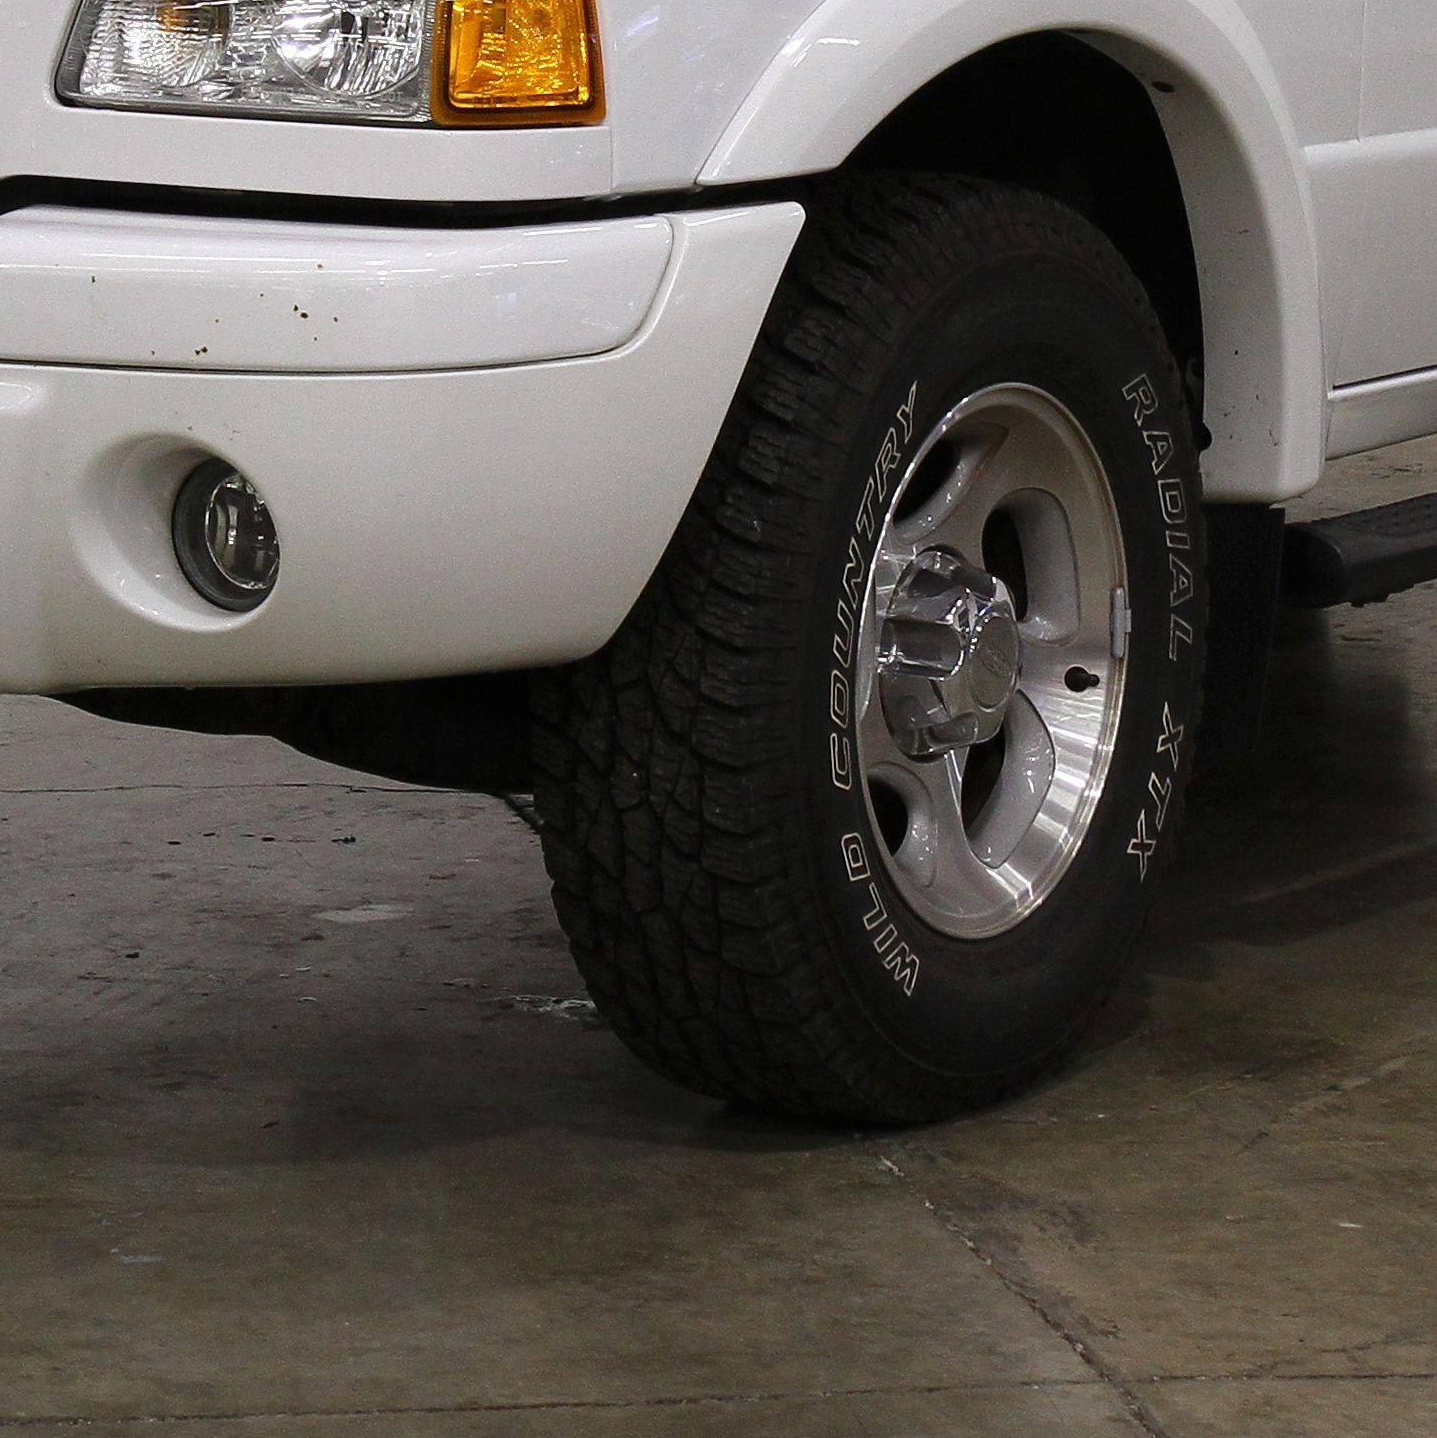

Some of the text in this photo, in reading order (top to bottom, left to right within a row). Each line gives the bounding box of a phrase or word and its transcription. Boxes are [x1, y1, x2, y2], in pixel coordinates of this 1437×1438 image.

[830, 380, 920, 997] WILD COUNTRY
[1121, 373, 1194, 662] RADIAL
